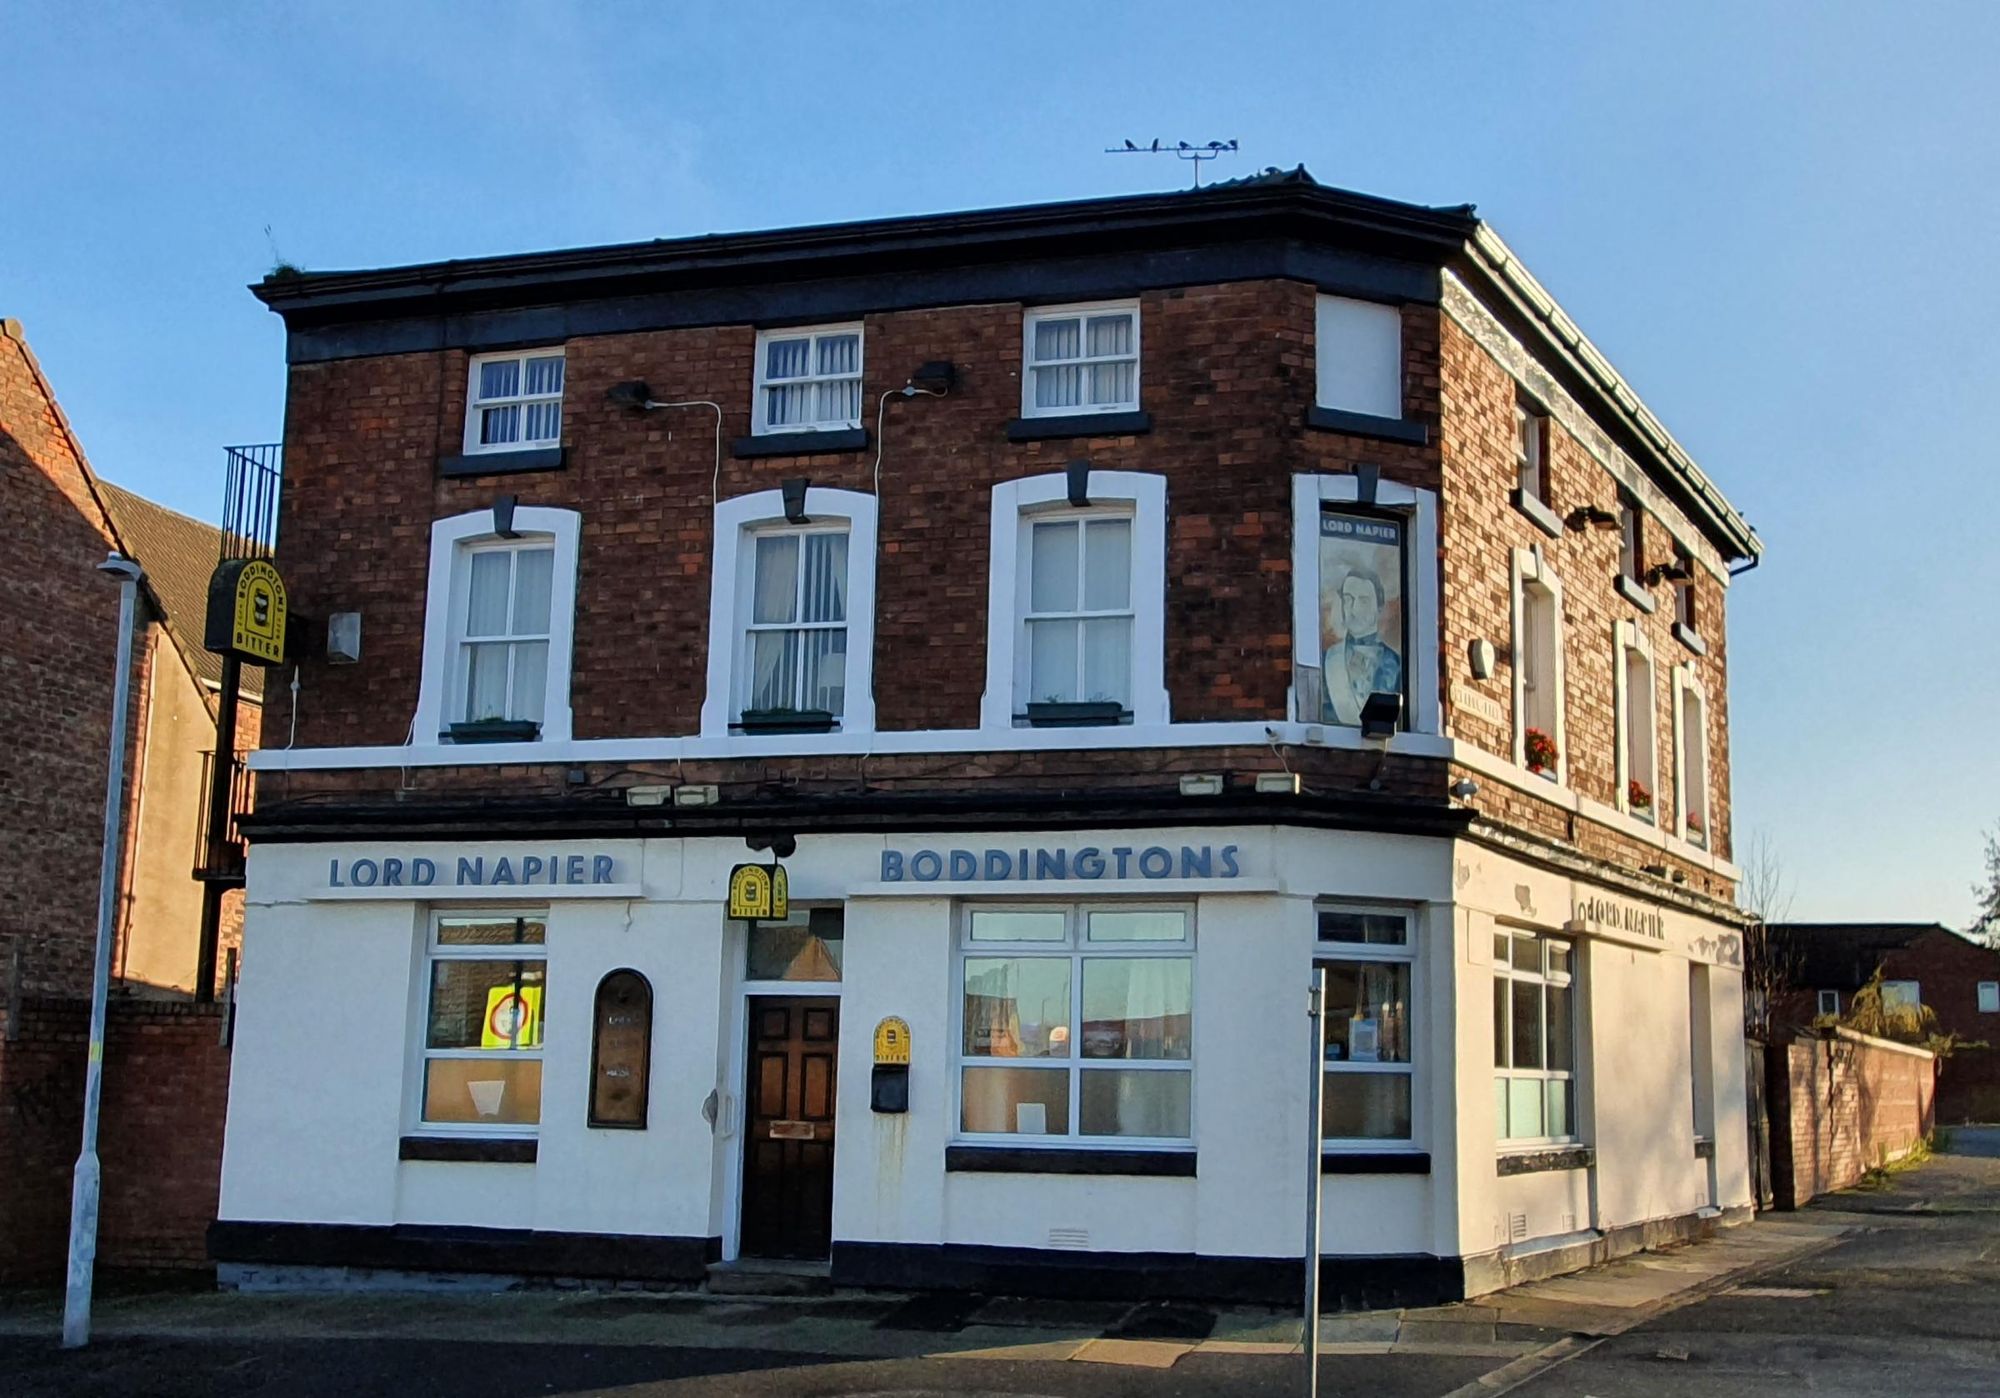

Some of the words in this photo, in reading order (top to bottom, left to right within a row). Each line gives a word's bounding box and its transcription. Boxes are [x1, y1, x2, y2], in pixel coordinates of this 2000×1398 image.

[1323, 520, 1353, 533] LORD
[1356, 524, 1396, 539] NAPIER
[238, 565, 284, 613] BODDINGTONS
[236, 631, 280, 657] BITTER
[329, 857, 437, 888] LORD
[456, 854, 615, 886] NAPIER
[880, 845, 1240, 882] BODDINGTONS
